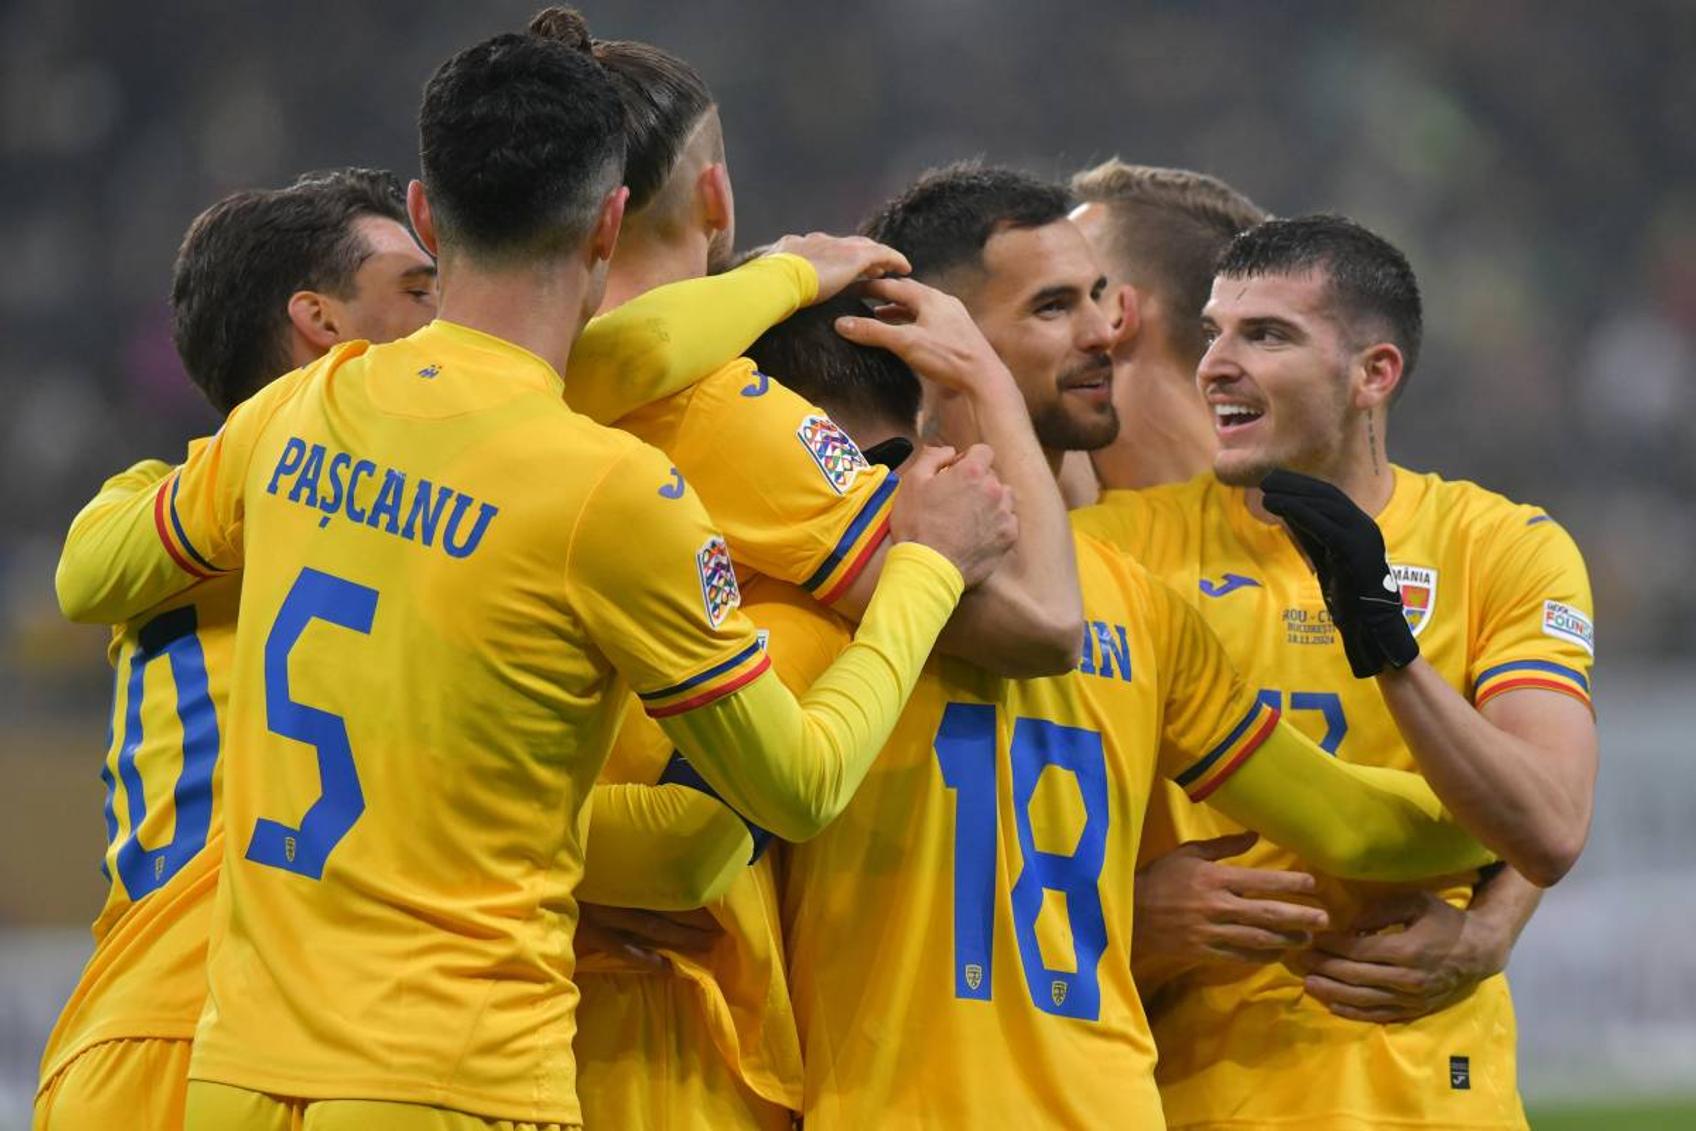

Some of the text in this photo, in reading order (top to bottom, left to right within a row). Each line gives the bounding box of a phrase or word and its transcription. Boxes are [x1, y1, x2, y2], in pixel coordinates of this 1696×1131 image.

[244, 566, 380, 881] 5
[1391, 566, 1431, 585] MÂNIA
[933, 701, 1109, 1021] 18
